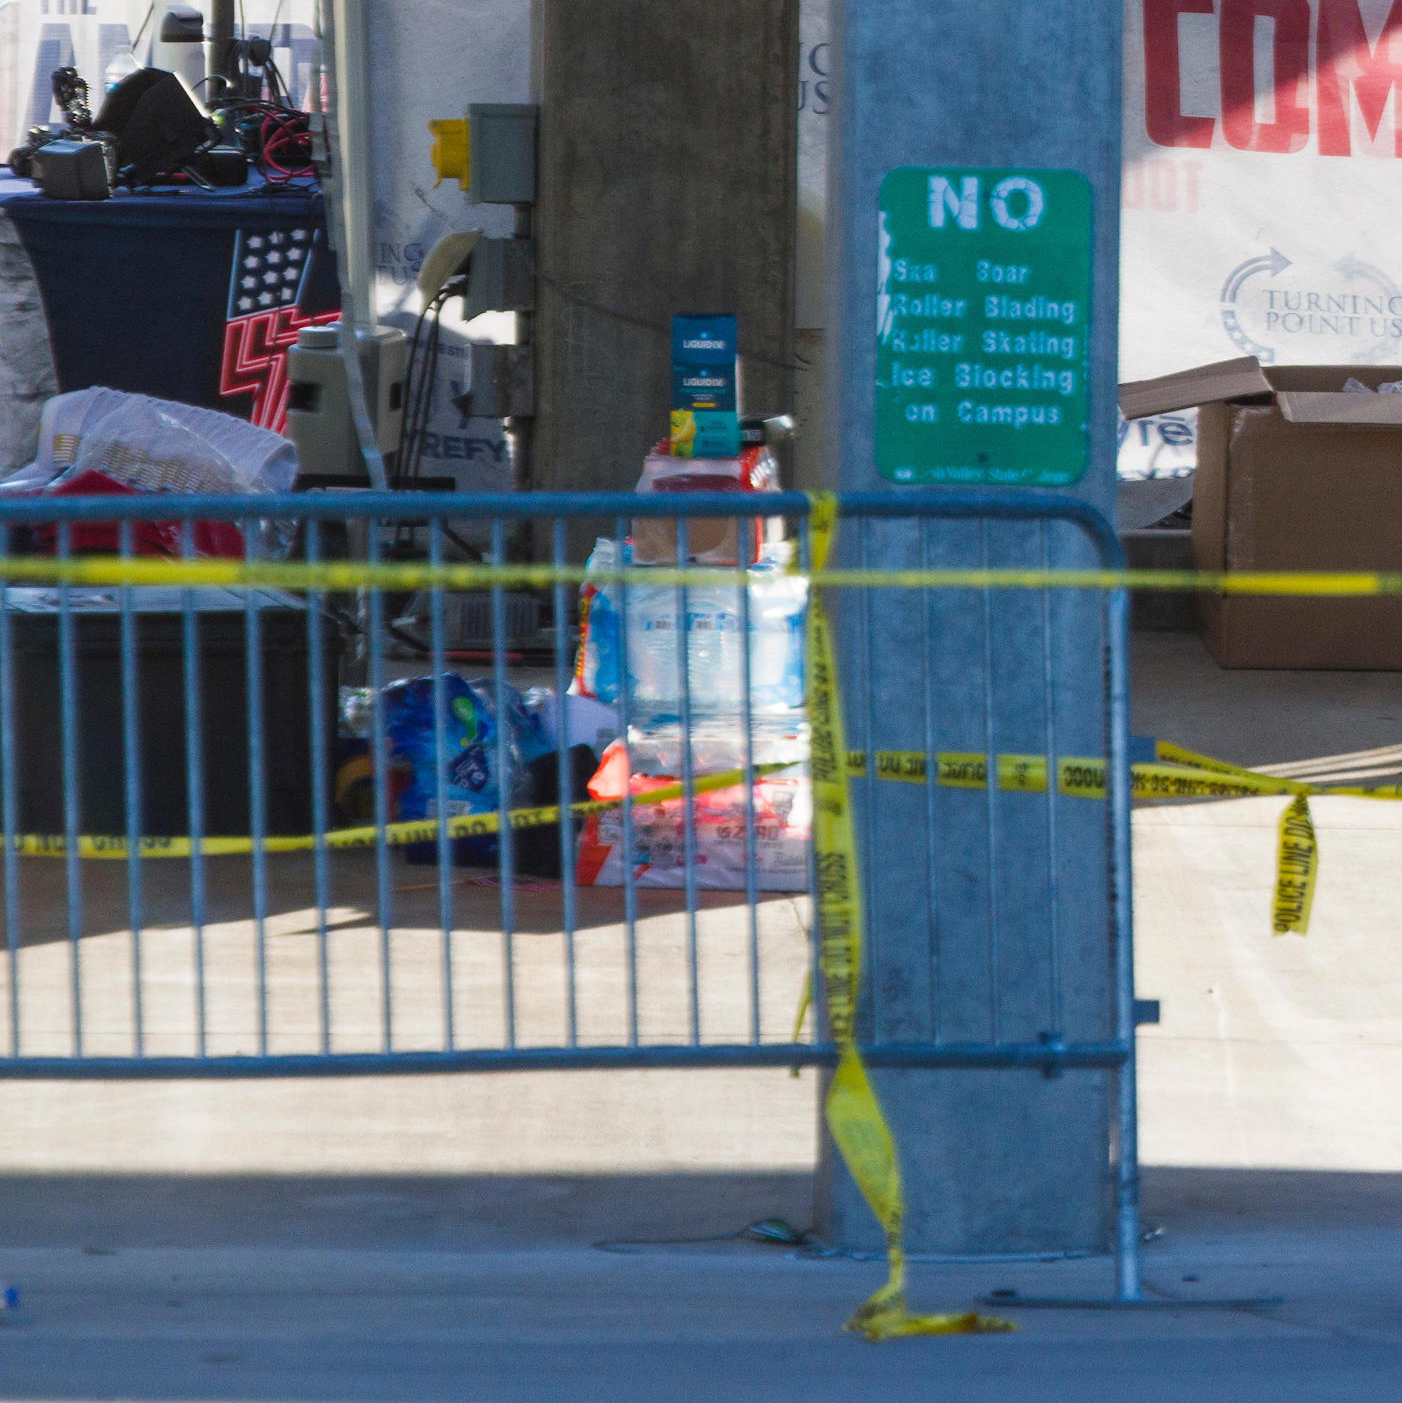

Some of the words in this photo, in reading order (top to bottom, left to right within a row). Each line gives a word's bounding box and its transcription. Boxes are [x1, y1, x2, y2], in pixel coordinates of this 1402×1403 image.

[928, 175, 1045, 230] NO
[984, 294, 1076, 325] Blading
[1266, 311, 1362, 338] POINT
[982, 329, 1076, 360] Skating
[891, 361, 933, 387] Ice
[955, 362, 1074, 394] Blocking
[905, 402, 936, 424] on
[957, 400, 1061, 430] Campus
[1283, 816, 1315, 841] DO
[1280, 841, 1313, 877] LINE
[1274, 878, 1307, 932] POLICE
